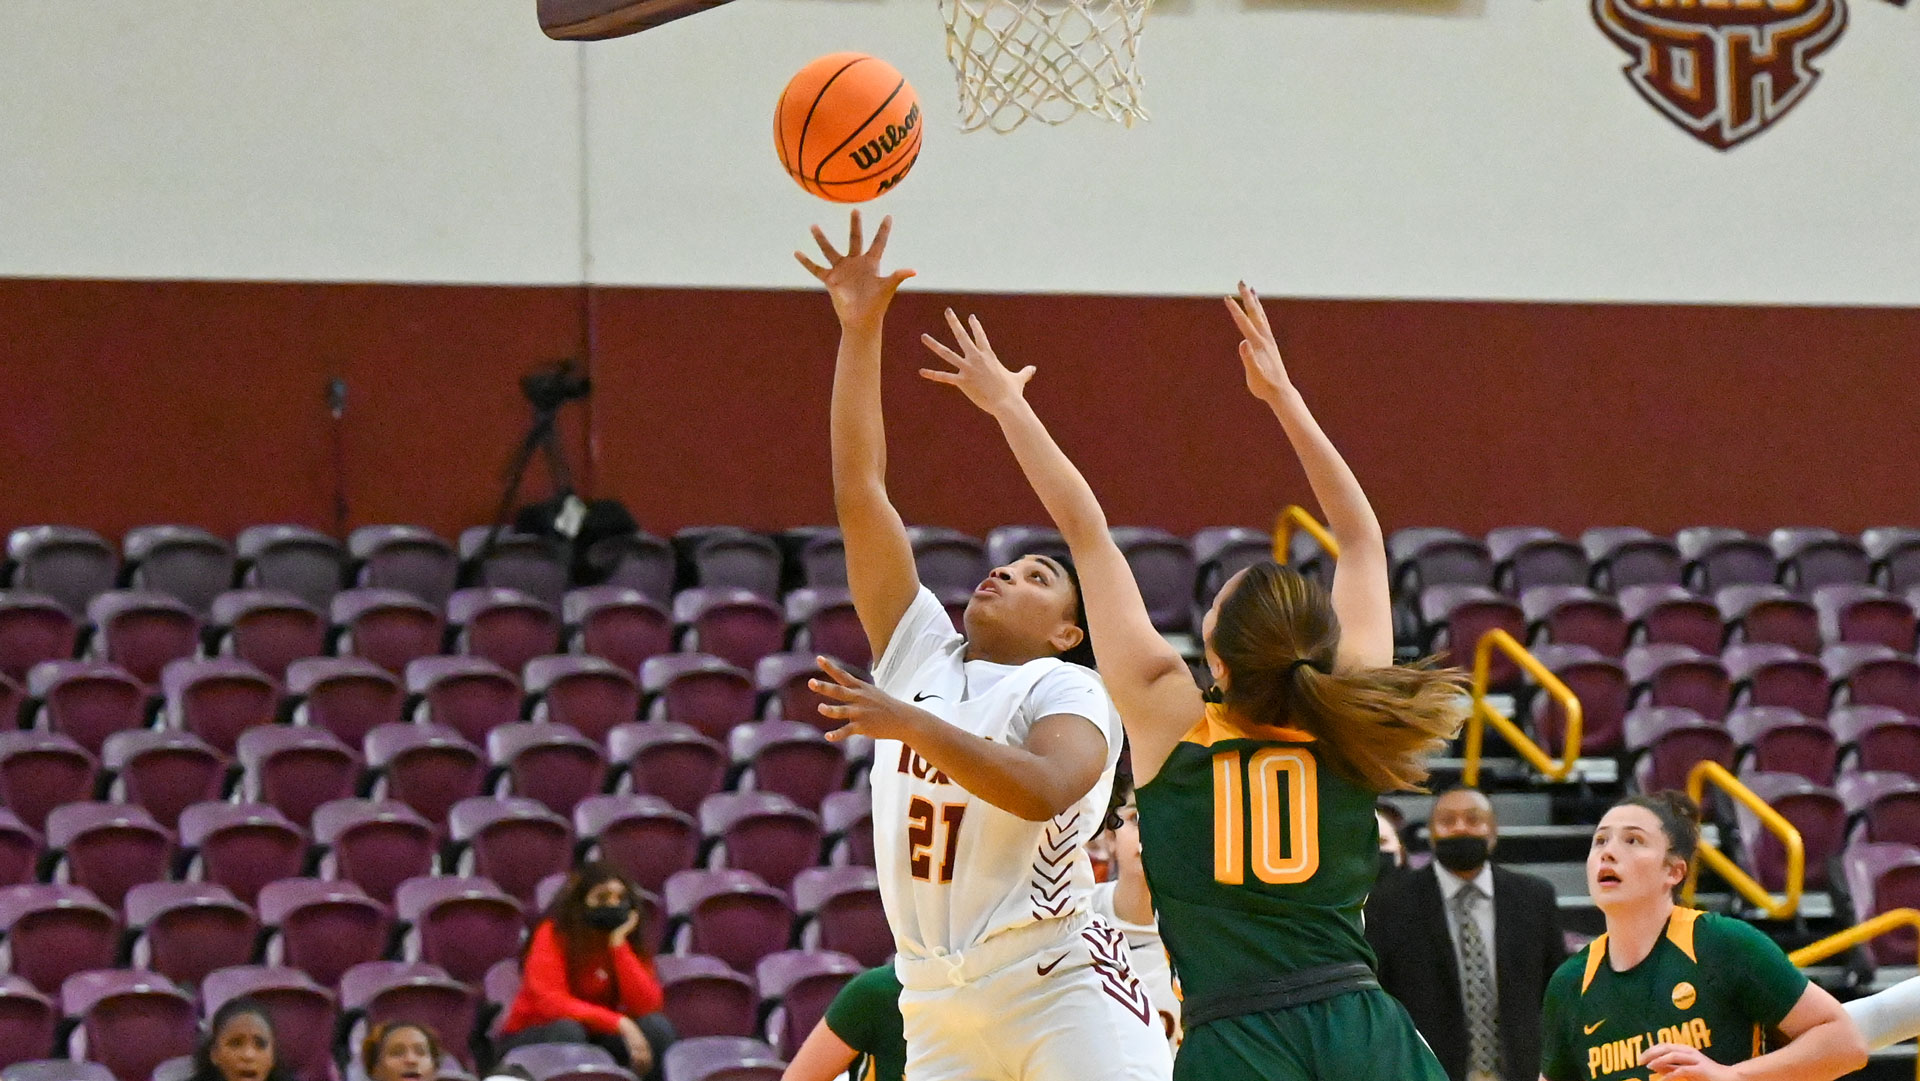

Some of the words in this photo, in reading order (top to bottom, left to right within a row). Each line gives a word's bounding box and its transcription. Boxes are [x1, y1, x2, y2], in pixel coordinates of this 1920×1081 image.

[1633, 26, 1812, 138] DH
[849, 101, 919, 170] Wilson
[908, 794, 968, 884] 21
[1212, 747, 1320, 885] 10
[1587, 1034, 1644, 1080] POINT
